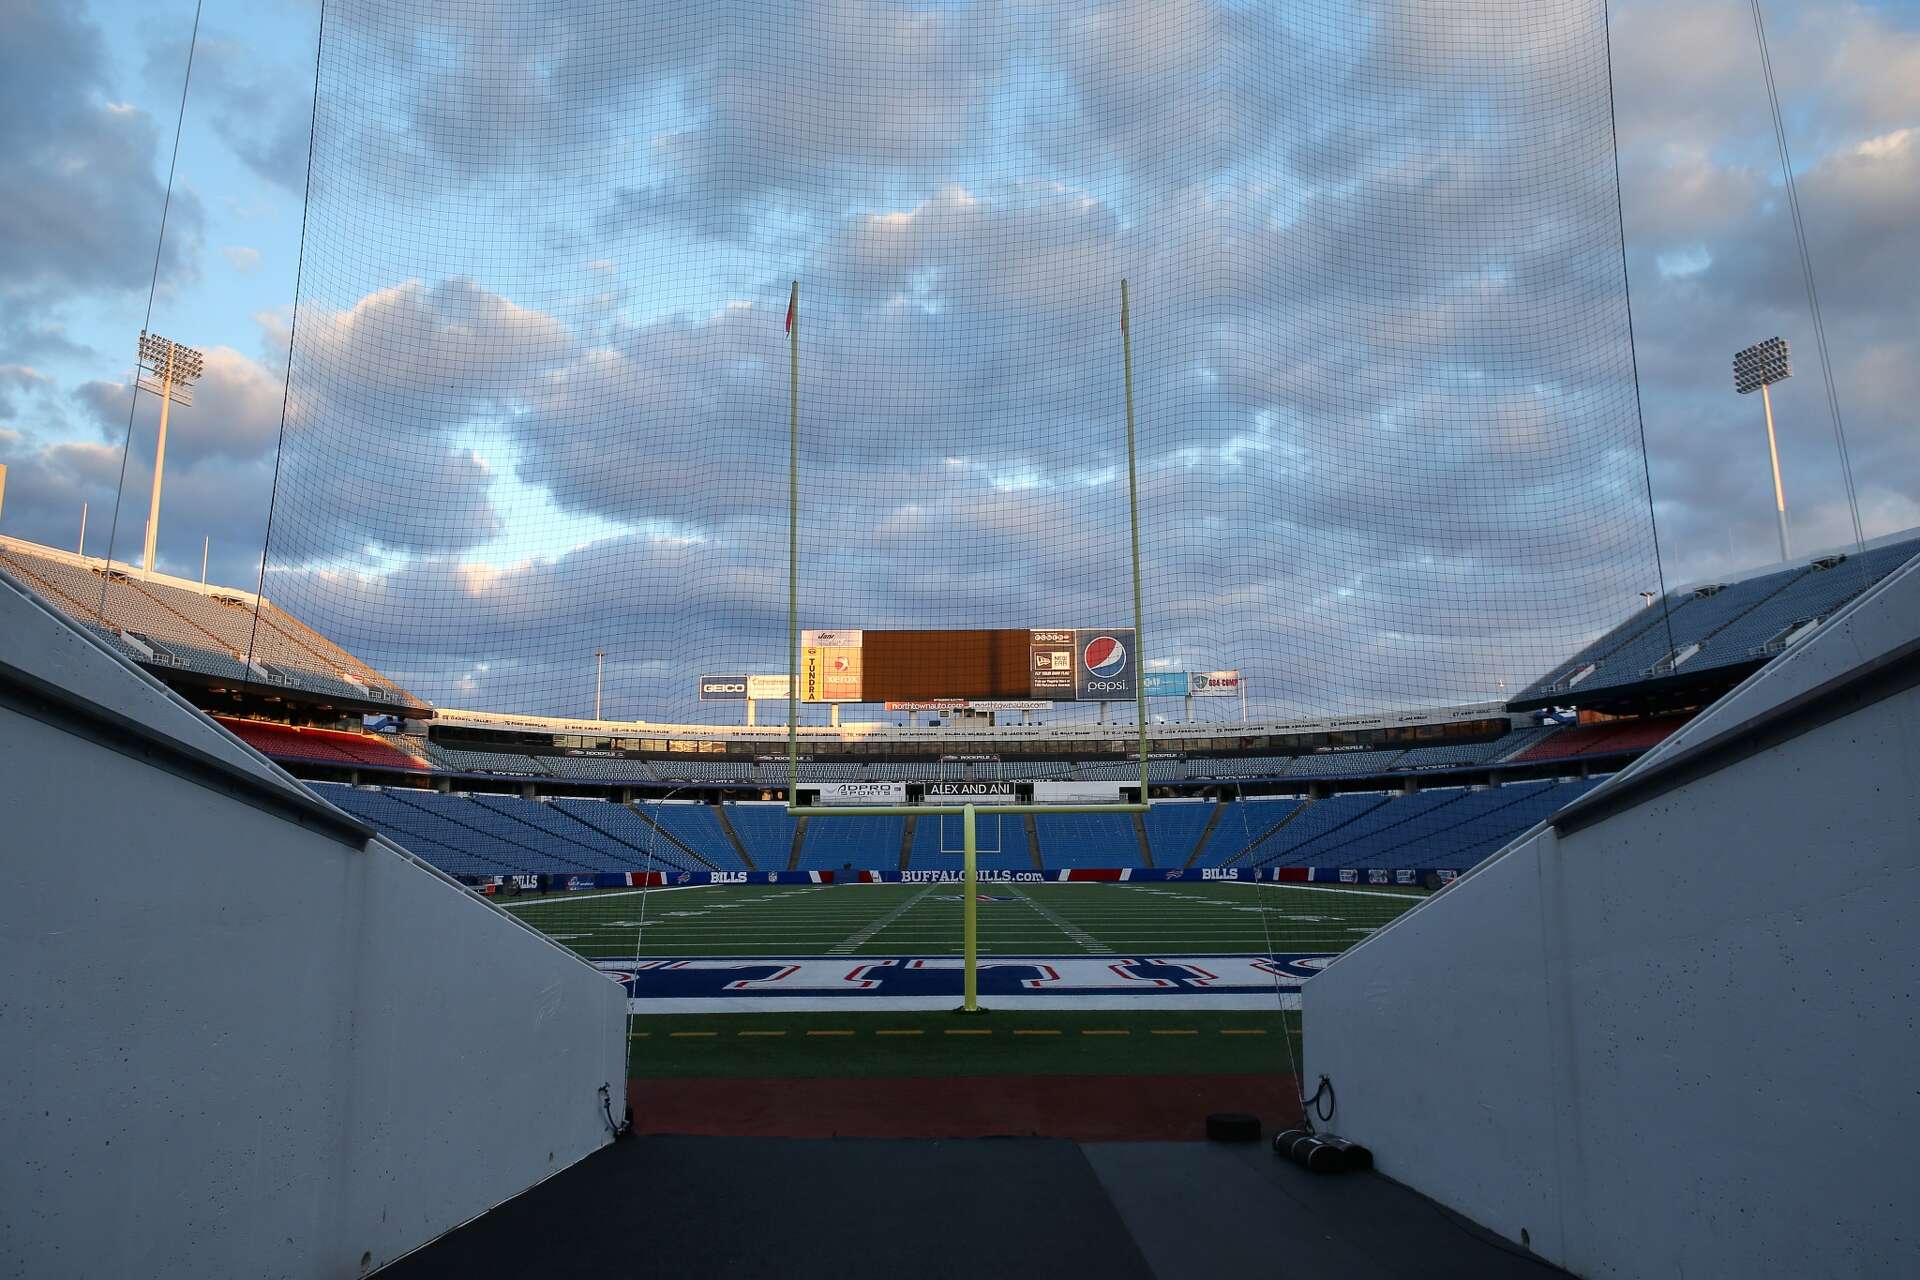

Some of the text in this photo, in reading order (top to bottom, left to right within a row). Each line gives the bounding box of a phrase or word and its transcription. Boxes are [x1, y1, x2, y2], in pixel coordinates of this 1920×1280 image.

[808, 658, 816, 701] TUNDRA
[827, 675, 857, 684] xerox
[703, 683, 745, 693] GEICO
[892, 702, 965, 710] northtownauto.com
[974, 701, 1046, 709] northtownauto.com
[838, 784, 891, 792] ADPRO
[930, 784, 1010, 794] ALEX AND ANI
[710, 871, 748, 883] BILLS
[1202, 867, 1239, 880] BILLS
